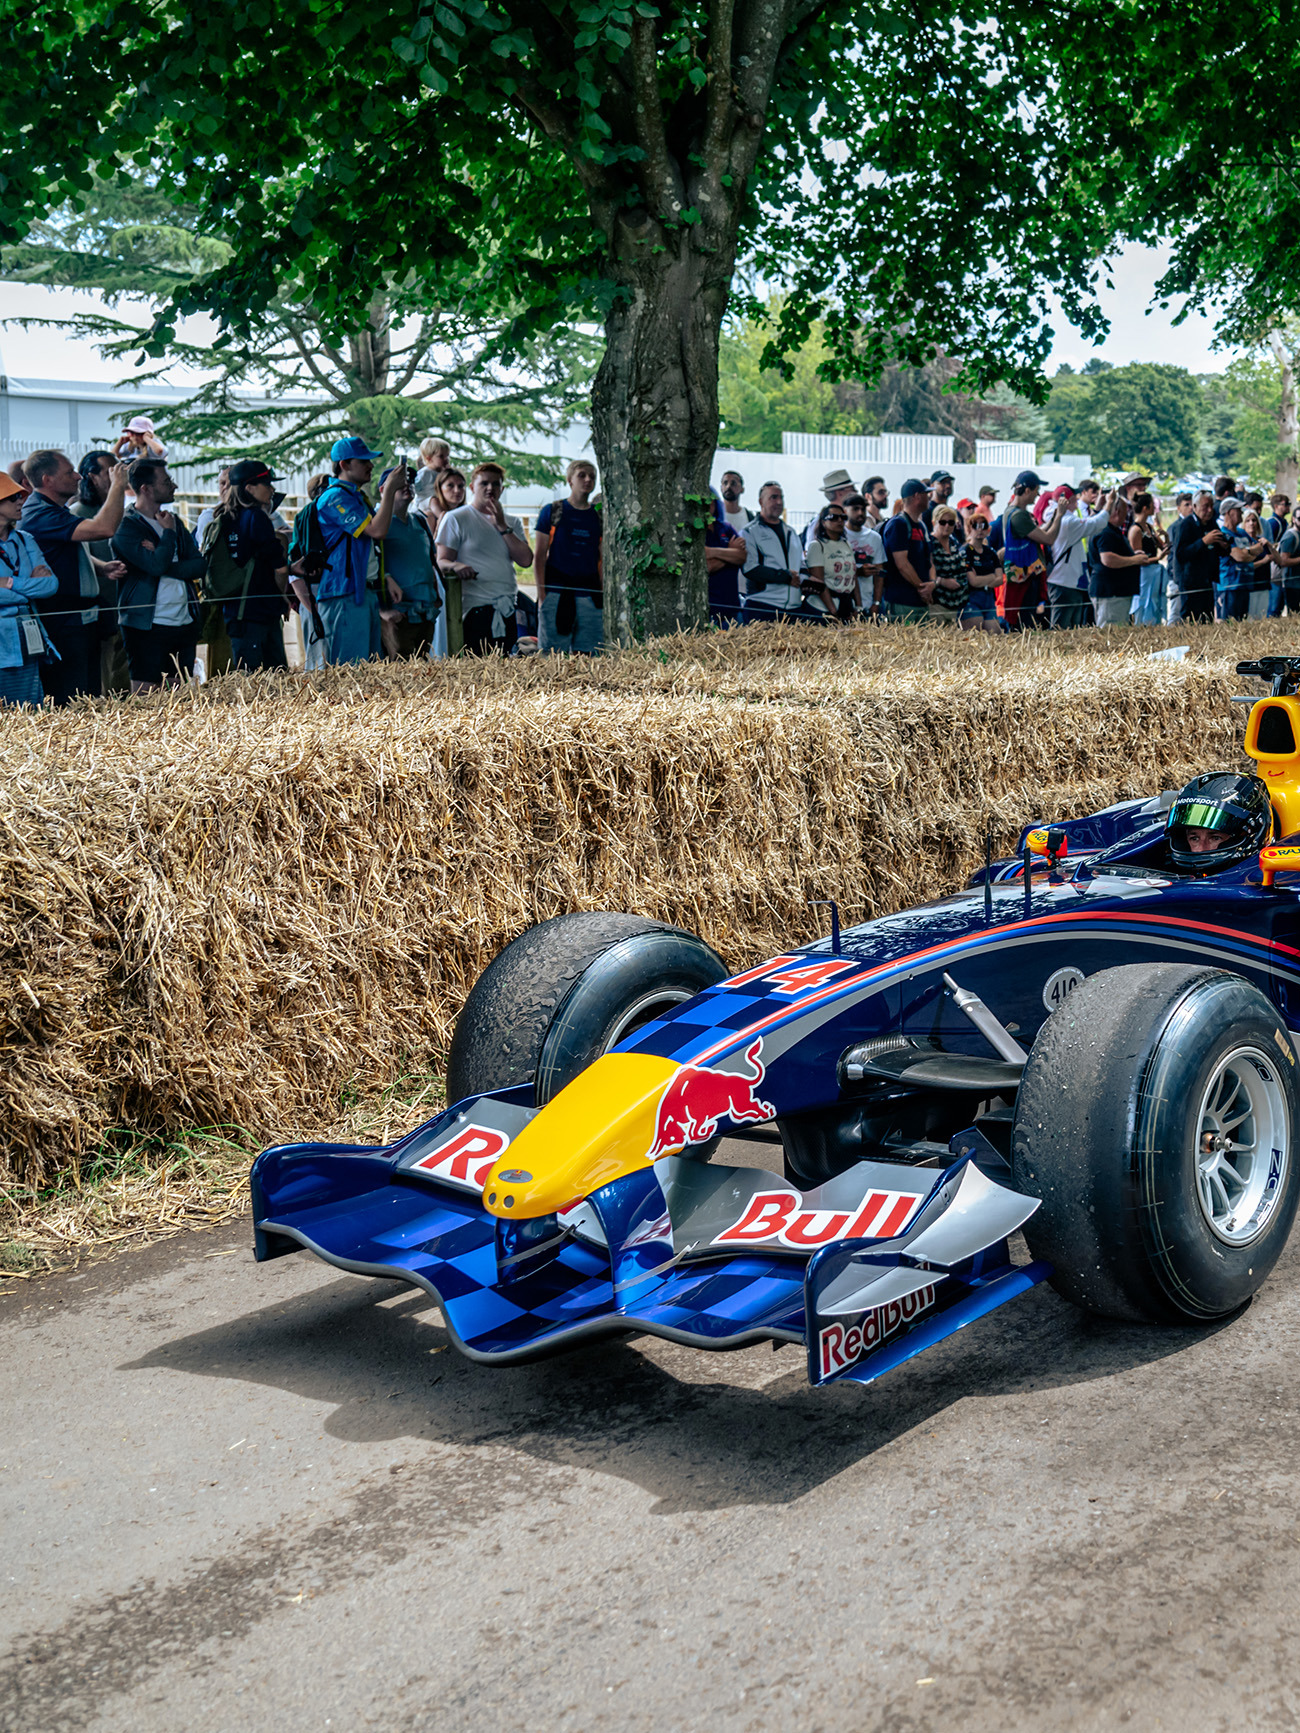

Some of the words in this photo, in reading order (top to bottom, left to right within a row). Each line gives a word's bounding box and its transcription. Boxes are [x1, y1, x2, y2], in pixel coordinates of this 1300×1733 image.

[1176, 797, 1219, 807] Motorsport
[716, 955, 861, 995] 14
[712, 1190, 922, 1248] Bull
